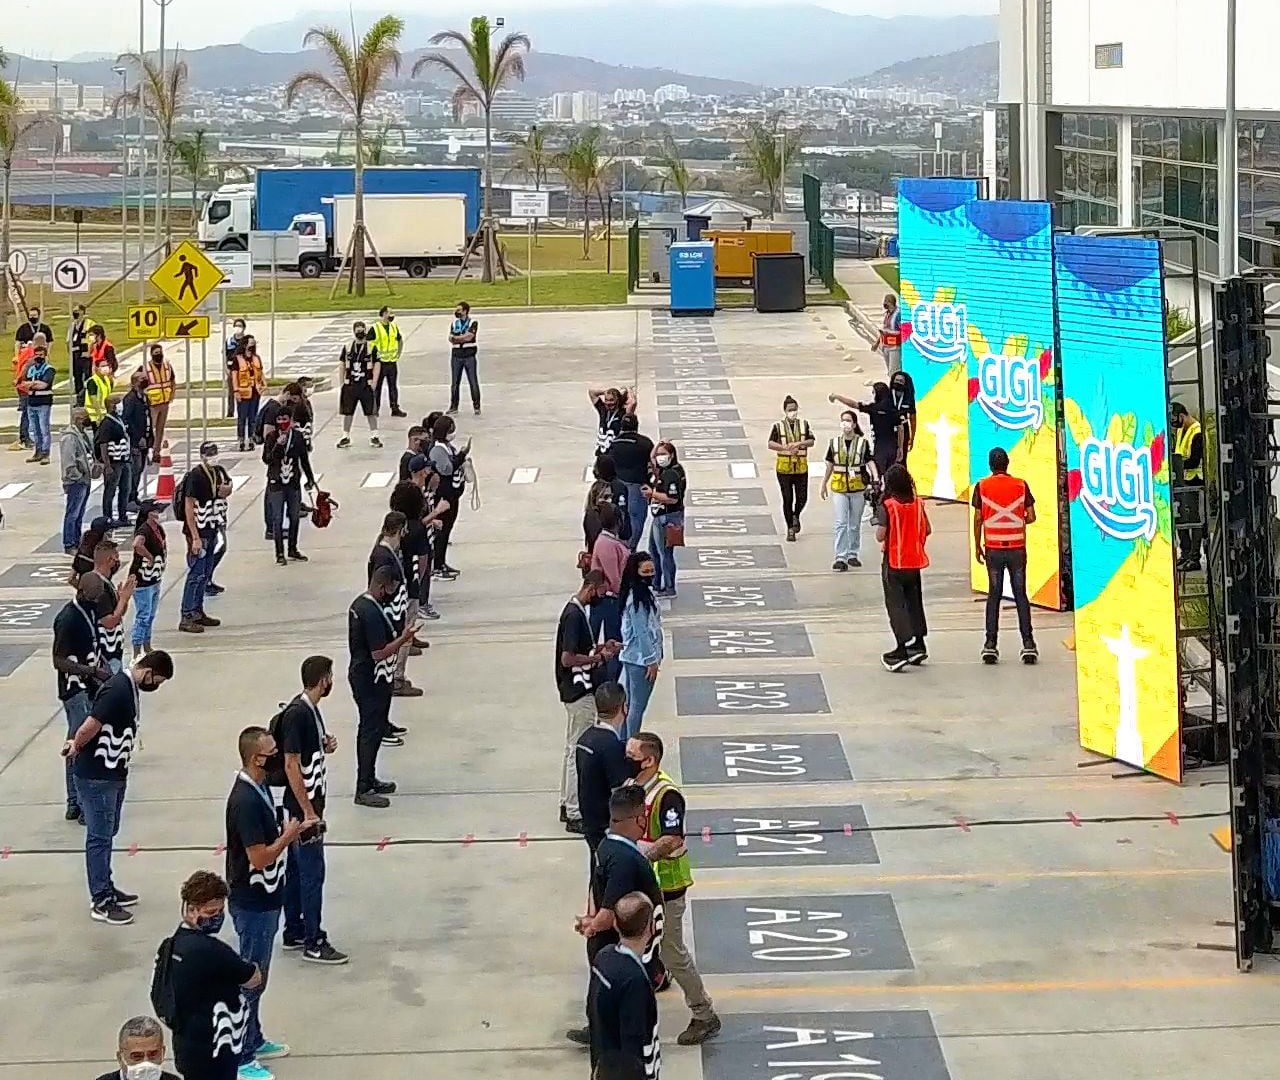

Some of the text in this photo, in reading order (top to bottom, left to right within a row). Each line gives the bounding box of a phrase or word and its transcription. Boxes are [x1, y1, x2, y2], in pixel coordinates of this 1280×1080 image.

[131, 310, 158, 327] 10
[913, 305, 966, 343] GIG1
[981, 355, 1041, 407] GIG1
[1082, 438, 1154, 507] GIG1
[694, 519, 748, 534] A27
[697, 549, 756, 568] A26
[702, 585, 766, 608] A25
[707, 630, 777, 655] A24
[715, 680, 790, 710] A23
[722, 741, 807, 778] A22
[733, 818, 827, 857] A21
[746, 907, 852, 961] A20
[763, 1025, 885, 1080] A1
